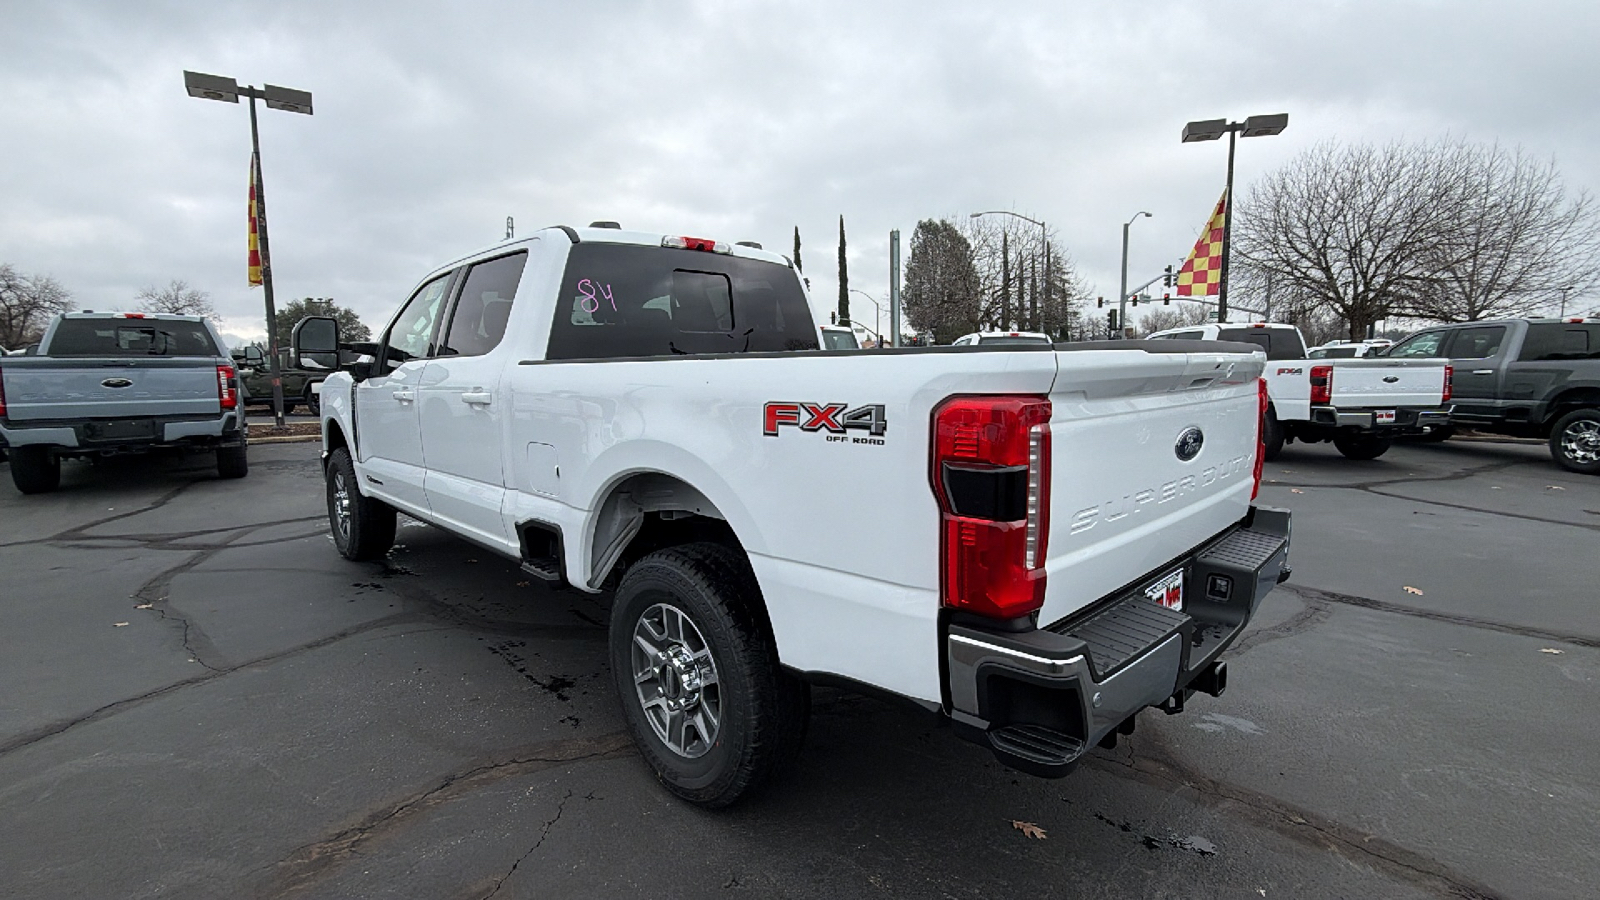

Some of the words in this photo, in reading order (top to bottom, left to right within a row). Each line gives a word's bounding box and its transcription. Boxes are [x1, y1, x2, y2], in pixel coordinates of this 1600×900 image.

[577, 278, 617, 313] 84
[763, 401, 887, 437] FX4
[826, 435, 848, 443] OFF
[852, 437, 885, 446] ROAD
[1070, 474, 1196, 536] SUPER
[1202, 453, 1253, 488] DUTY
